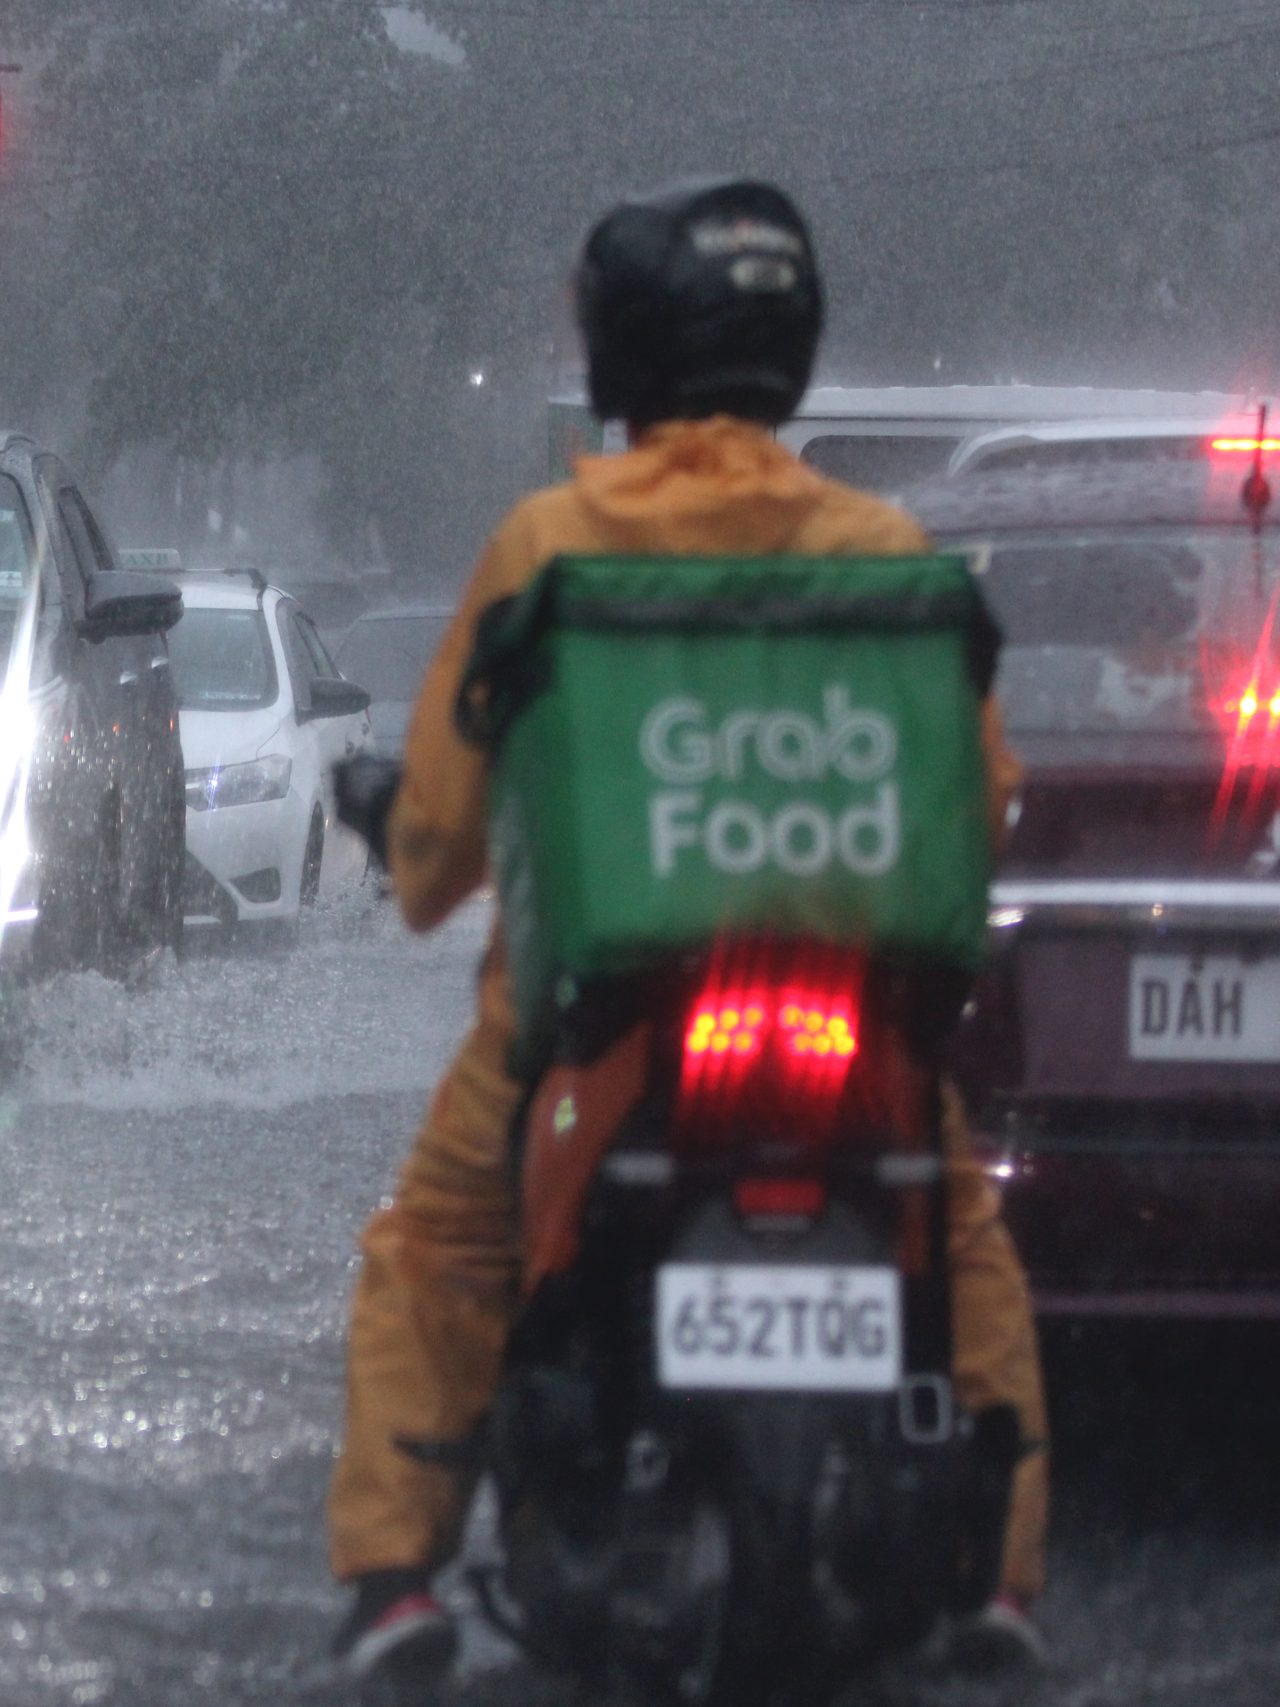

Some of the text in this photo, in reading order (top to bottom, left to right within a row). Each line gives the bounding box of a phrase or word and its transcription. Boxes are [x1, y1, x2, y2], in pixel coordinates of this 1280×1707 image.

[639, 684, 898, 784] Grab
[651, 782, 899, 877] Food
[1140, 977, 1243, 1037] DAH
